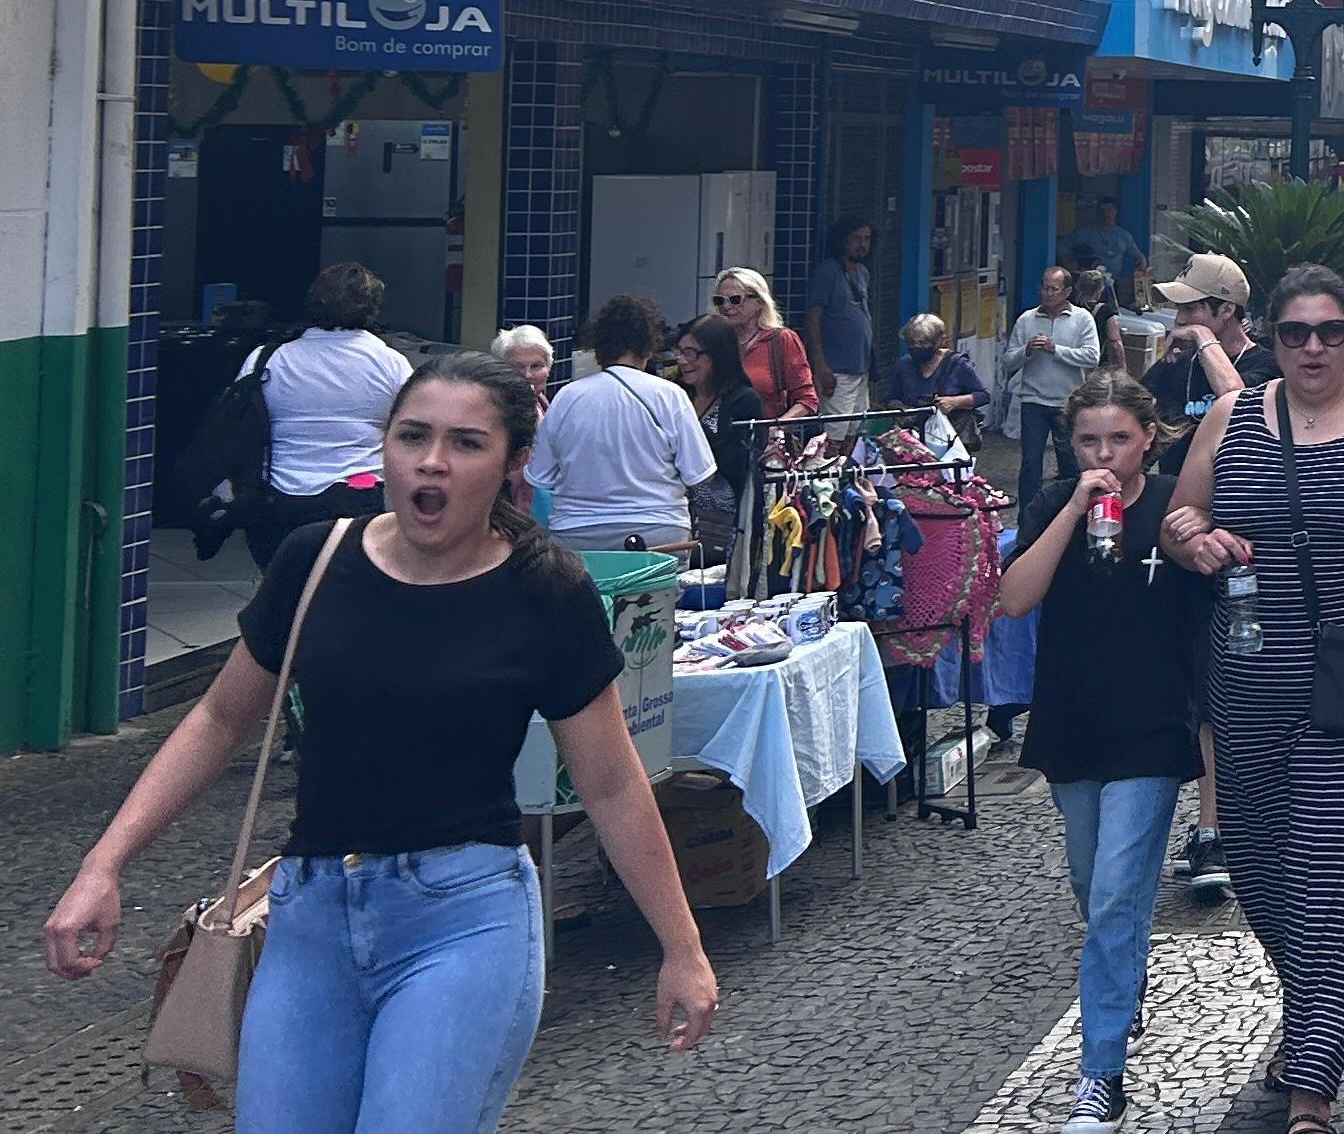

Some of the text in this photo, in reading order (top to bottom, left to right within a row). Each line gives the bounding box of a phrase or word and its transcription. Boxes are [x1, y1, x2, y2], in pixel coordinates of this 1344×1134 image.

[335, 35, 493, 60] Bom de comprar
[642, 690, 674, 713] Grossa
